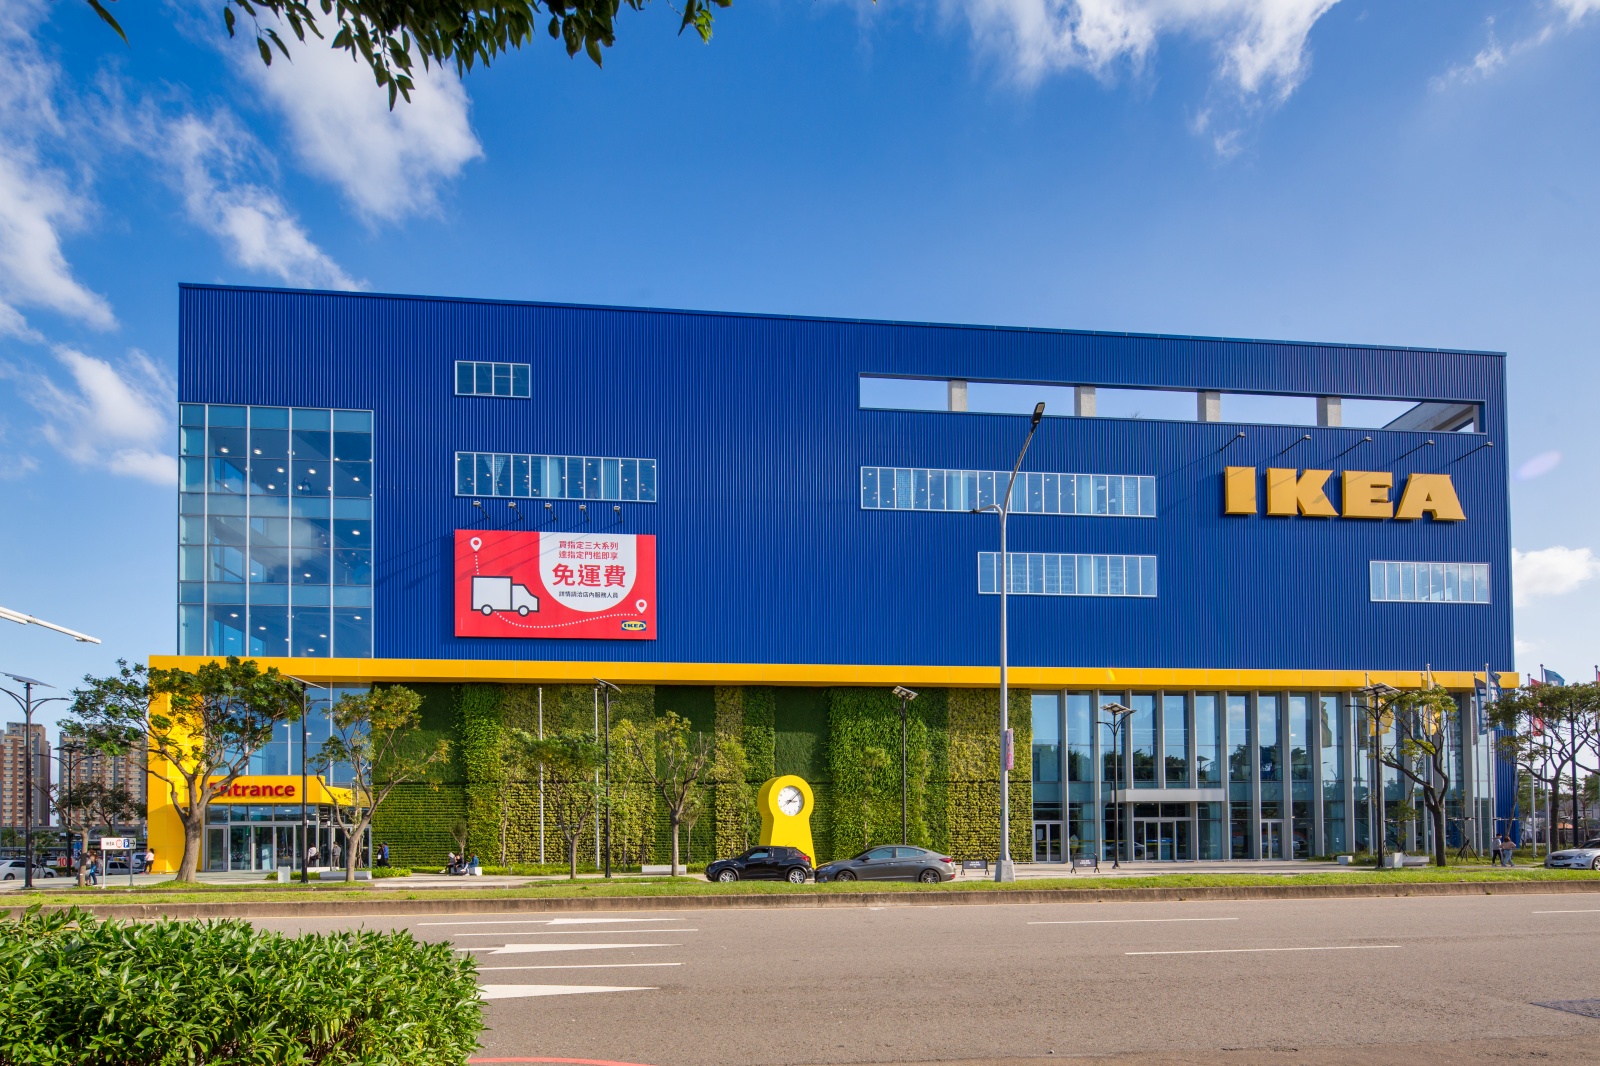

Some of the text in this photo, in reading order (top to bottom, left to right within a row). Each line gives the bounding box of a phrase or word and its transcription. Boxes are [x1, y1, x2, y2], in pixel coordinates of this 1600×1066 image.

[1224, 466, 1467, 521] IKEA
[559, 540, 619, 550] 買指定三大系列
[552, 563, 626, 588] 免運費
